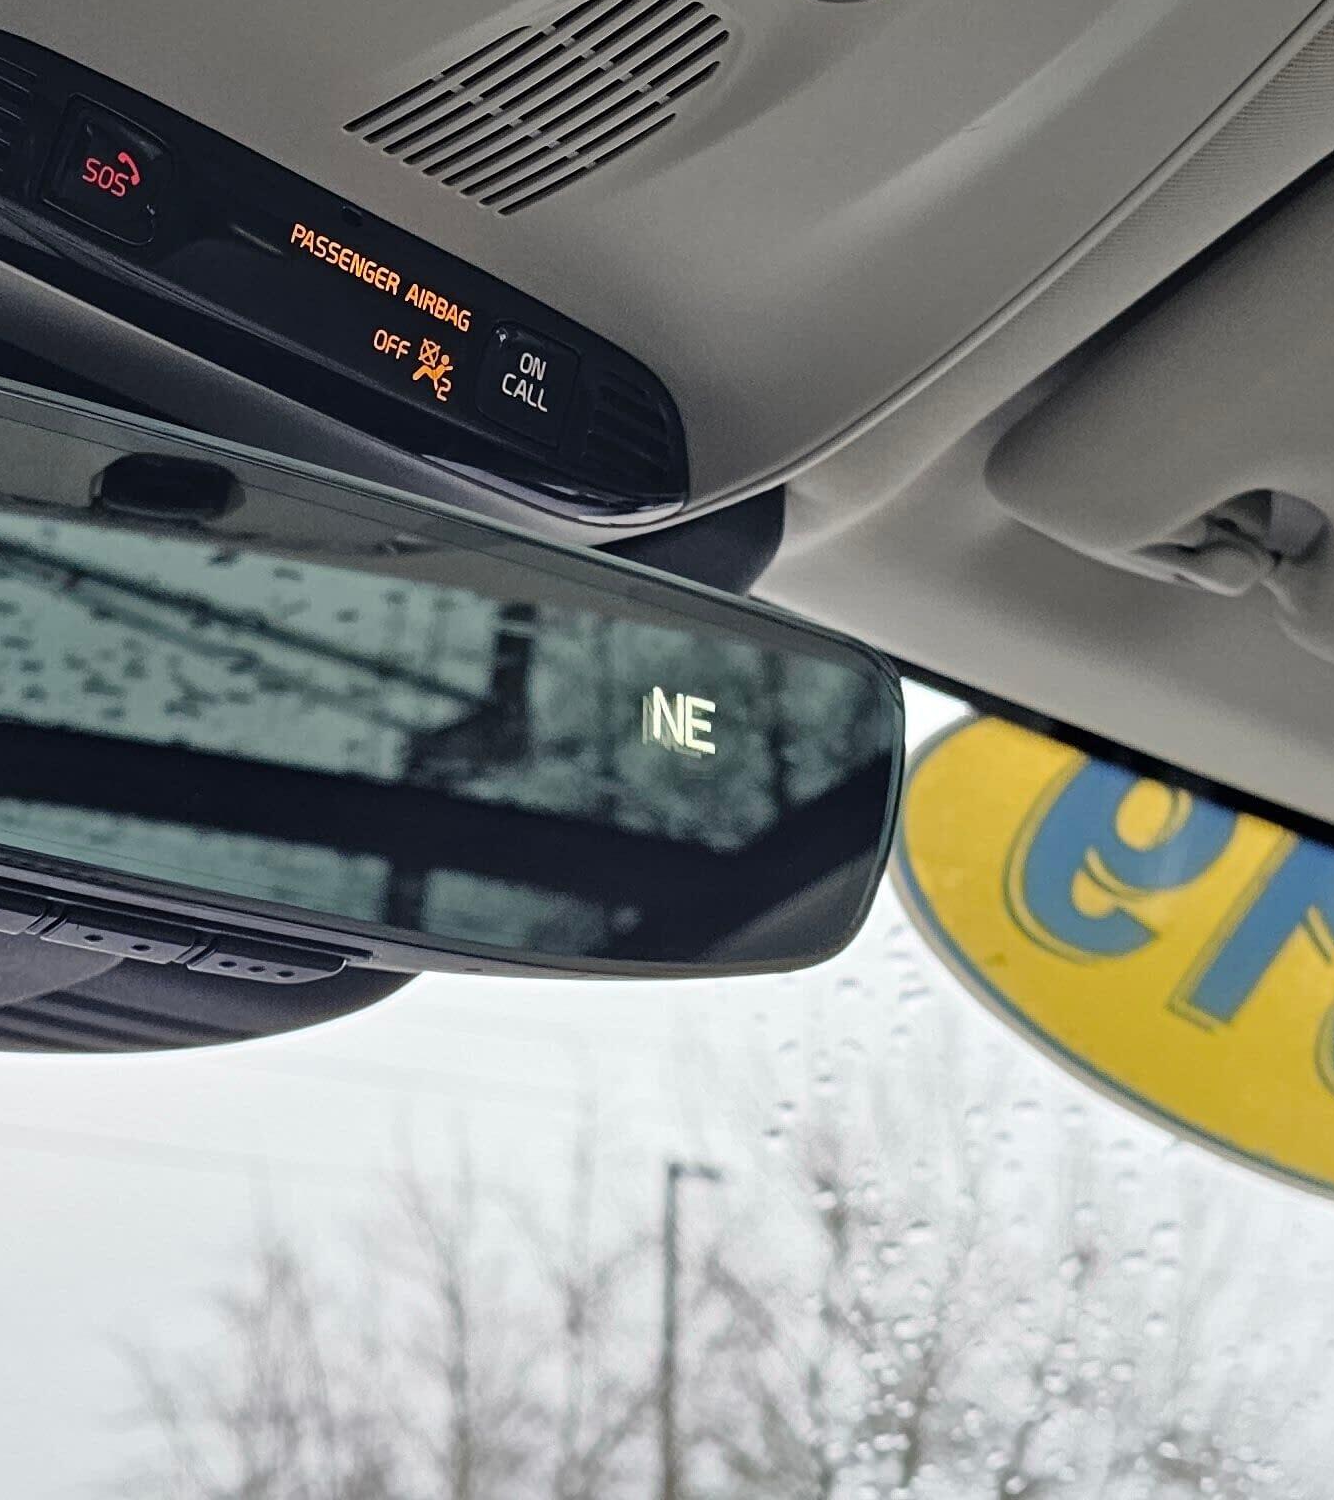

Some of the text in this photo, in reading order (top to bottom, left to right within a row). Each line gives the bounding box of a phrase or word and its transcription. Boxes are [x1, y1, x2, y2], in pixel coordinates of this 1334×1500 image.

[82, 158, 130, 197] SOS
[290, 223, 472, 333] PASSENGER AIRBAG
[373, 329, 411, 360] OFF
[519, 352, 547, 381] ON
[501, 373, 548, 413] CALL
[652, 685, 716, 755] NE
